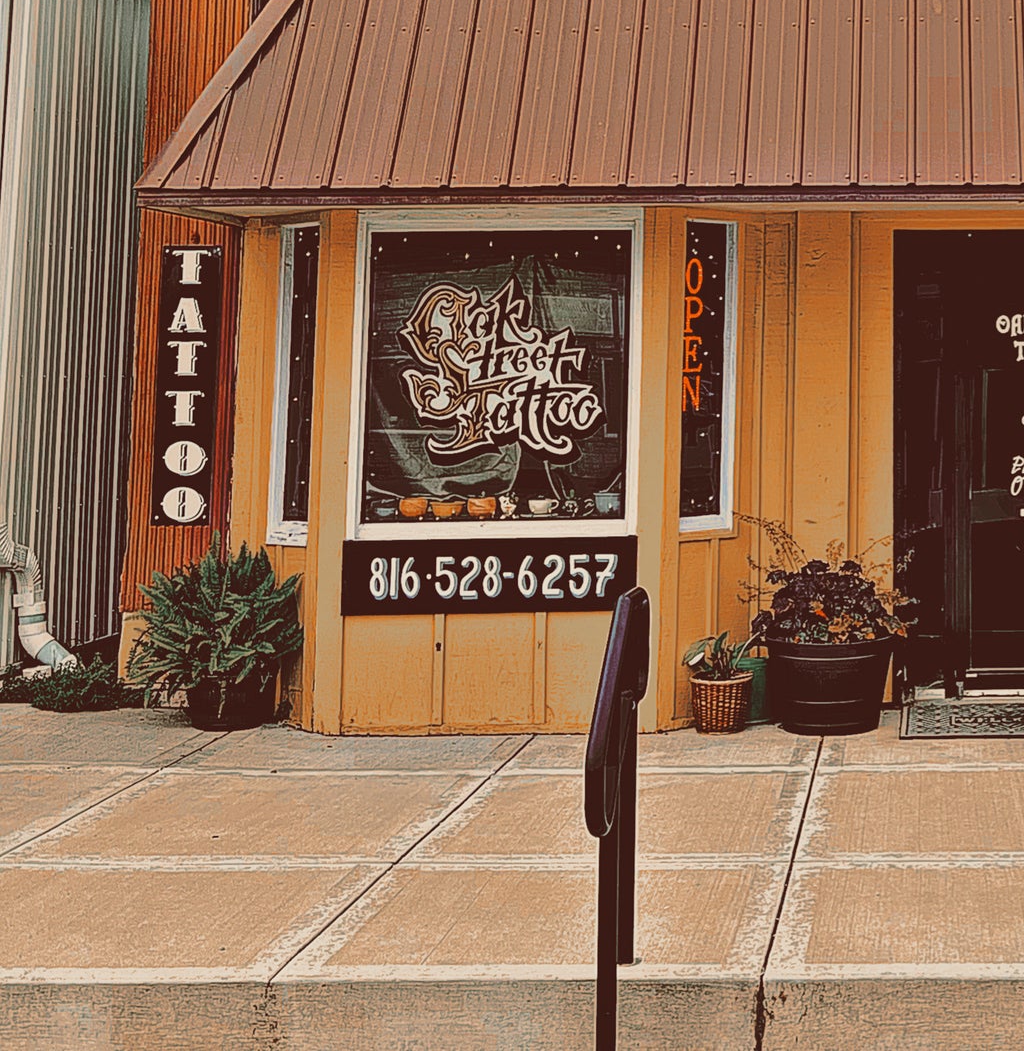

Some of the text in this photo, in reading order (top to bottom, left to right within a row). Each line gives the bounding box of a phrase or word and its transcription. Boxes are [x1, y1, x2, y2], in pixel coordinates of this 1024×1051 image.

[400, 278, 542, 367] Oak
[682, 258, 704, 411] OPEN
[160, 250, 212, 522] TATTOO
[402, 329, 586, 421] Street
[427, 375, 603, 455] Tattoo
